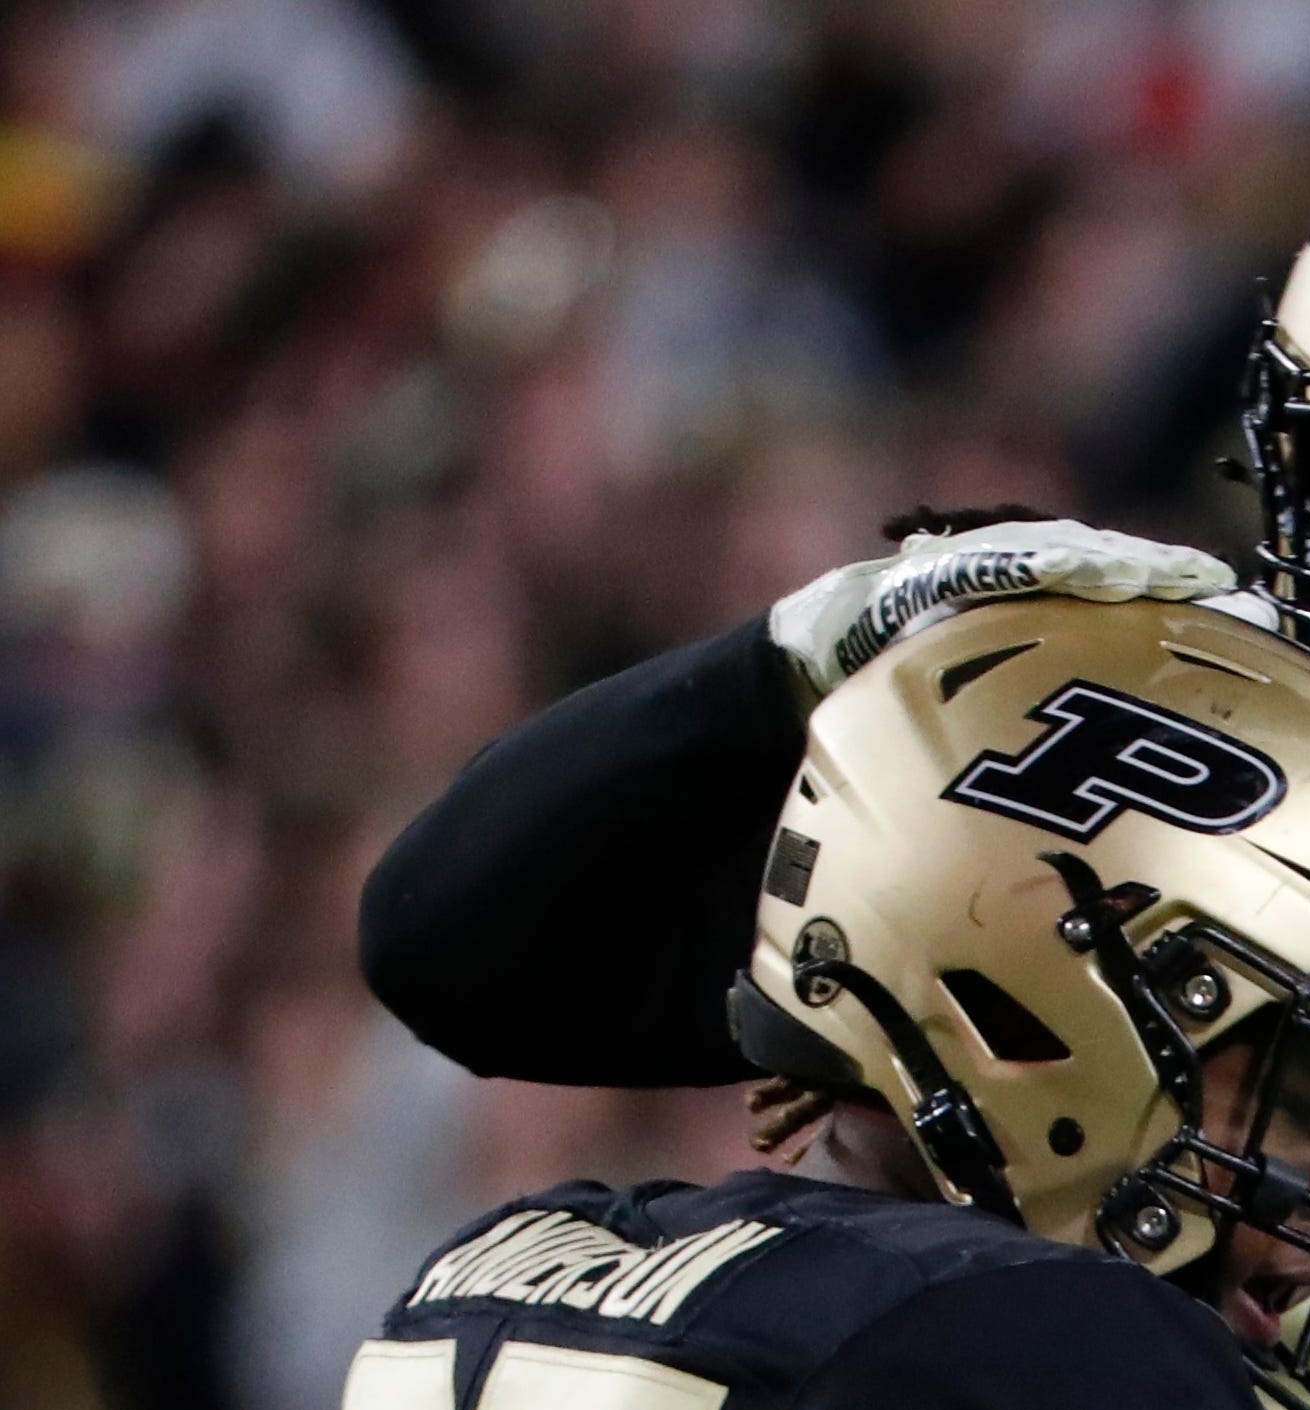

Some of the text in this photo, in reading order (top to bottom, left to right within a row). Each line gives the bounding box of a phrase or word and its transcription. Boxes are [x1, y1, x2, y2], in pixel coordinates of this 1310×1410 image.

[834, 549, 1042, 677] BOILERMAKERS
[938, 676, 1288, 845] P
[405, 1209, 785, 1326] ANDERSON
